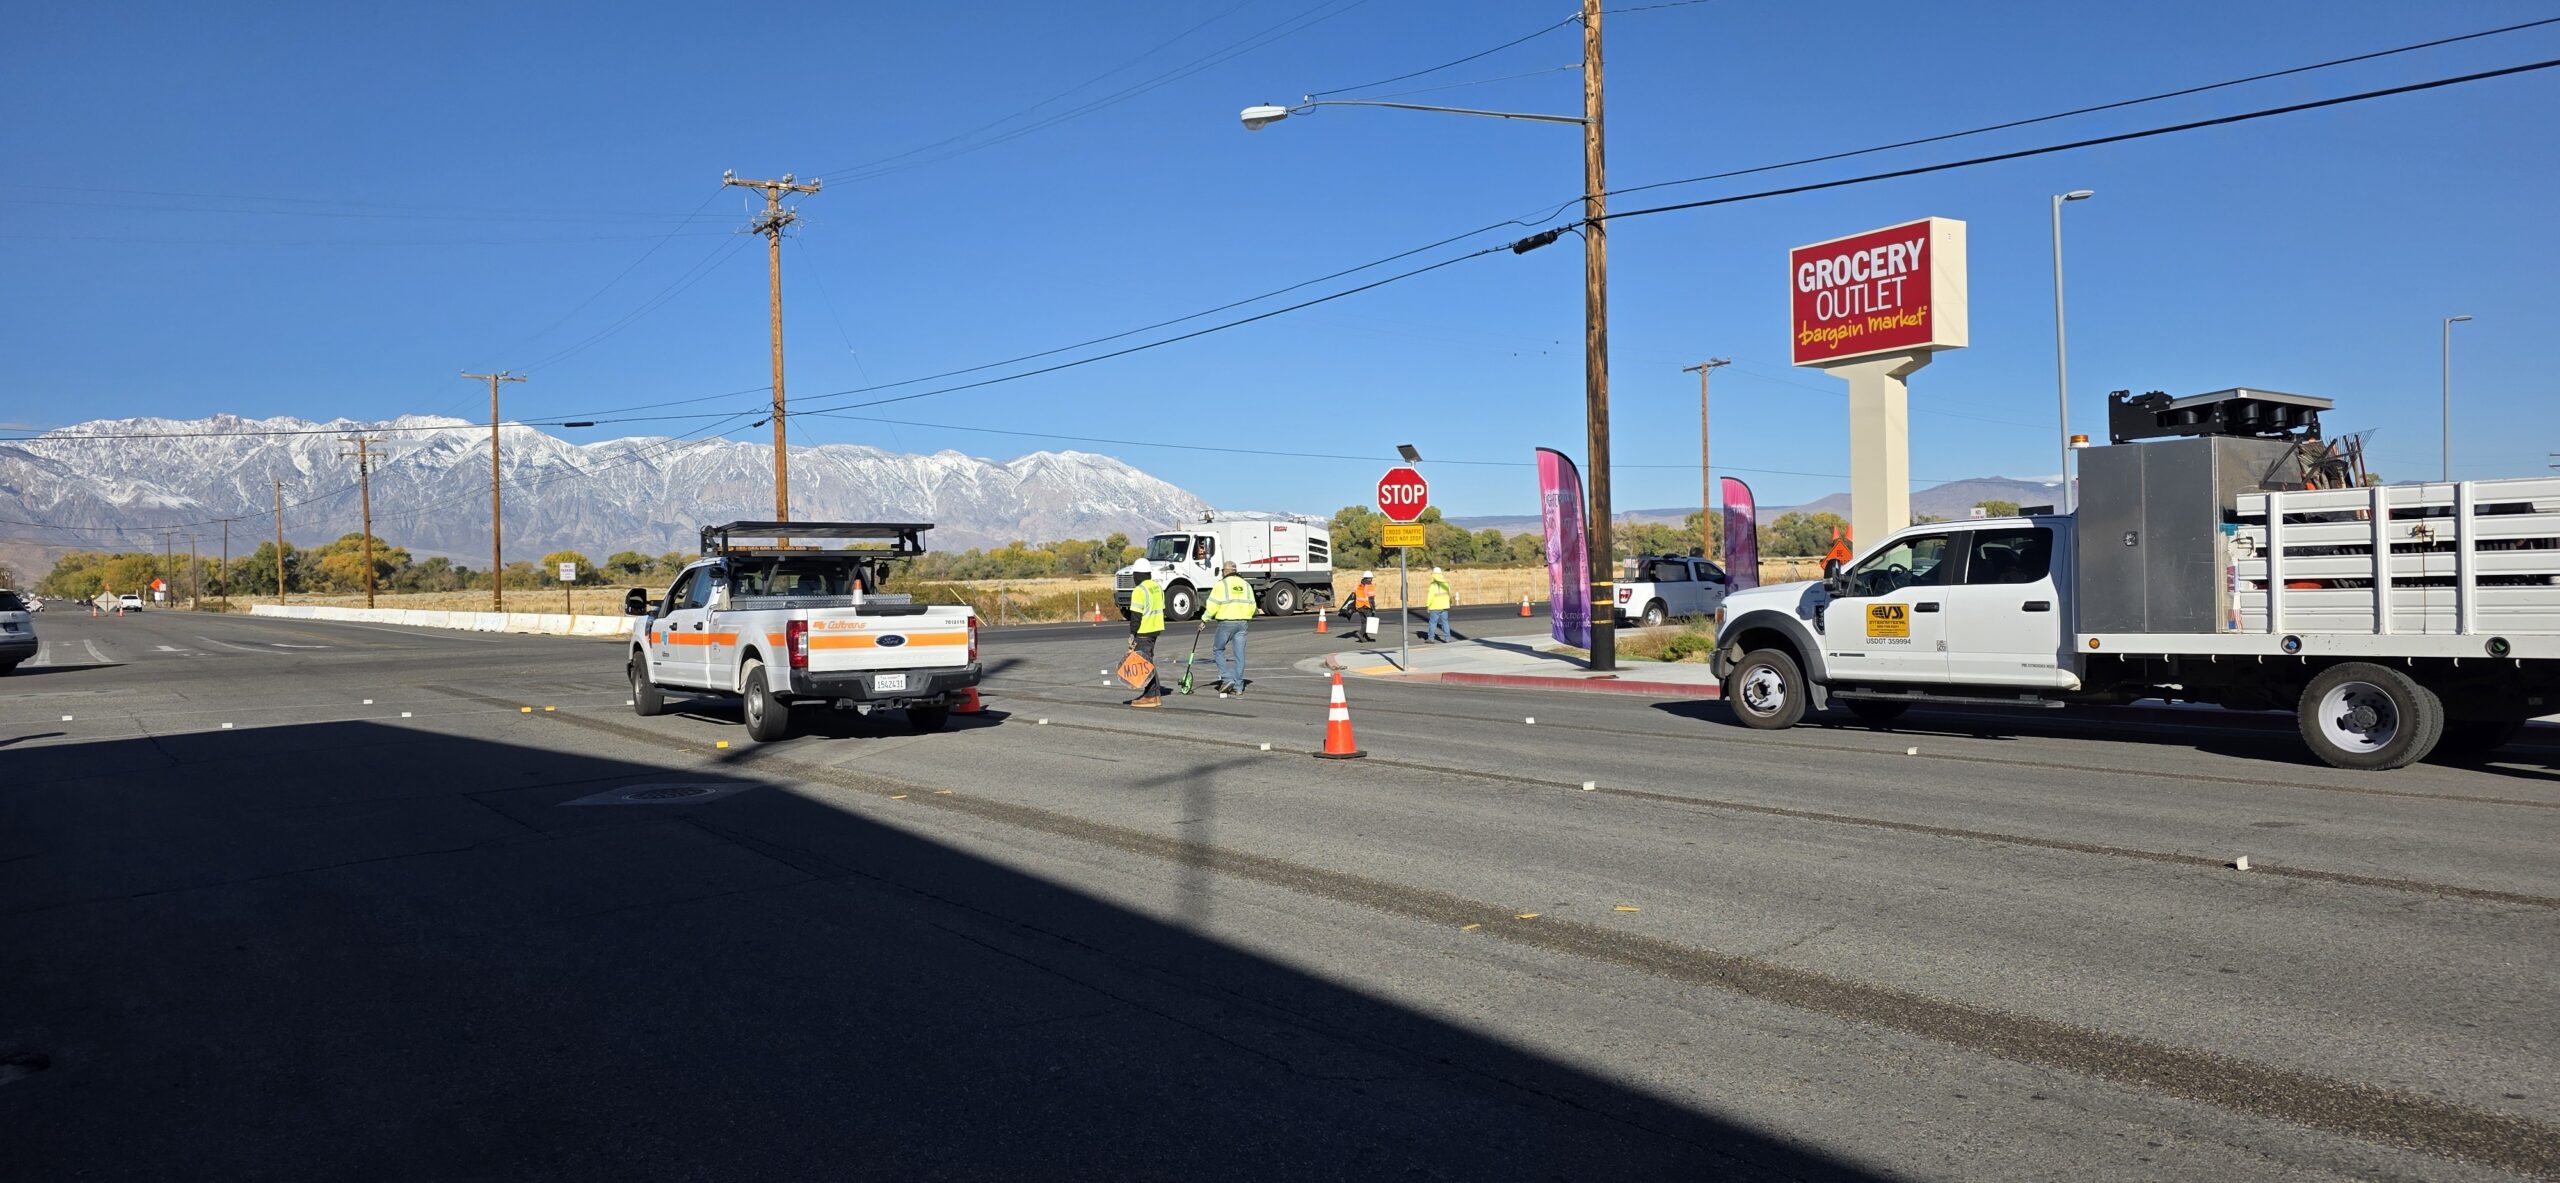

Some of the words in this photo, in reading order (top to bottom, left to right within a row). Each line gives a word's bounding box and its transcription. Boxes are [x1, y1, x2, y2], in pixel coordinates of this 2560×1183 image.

[1798, 238, 1925, 293] GROCERY
[1816, 275, 1907, 321] OUTLET
[1798, 320, 1864, 350] bargain
[1868, 306, 1926, 334] market
[1381, 484, 1425, 505] STOP
[828, 620, 867, 629] Caltrans
[1124, 661, 1150, 678] SLOW
[877, 680, 904, 689] 1542431
